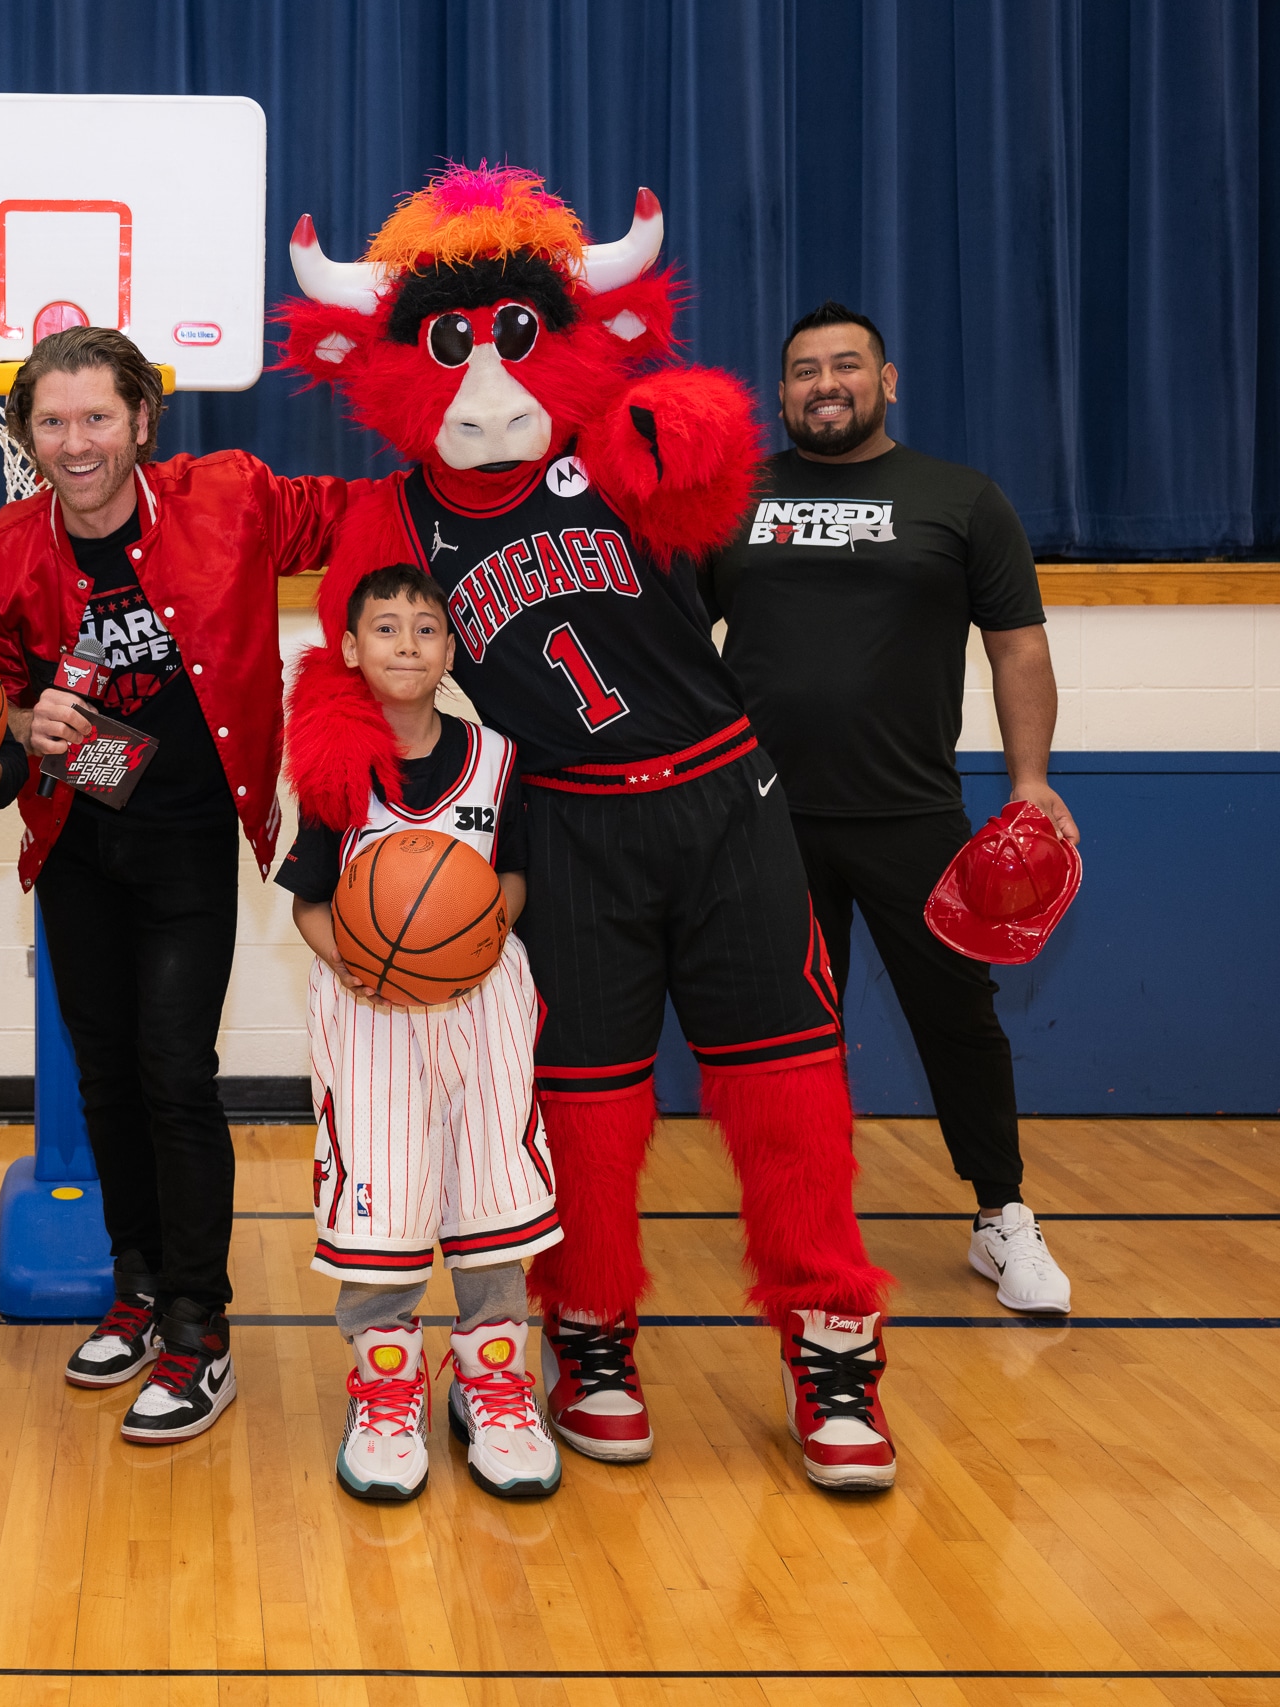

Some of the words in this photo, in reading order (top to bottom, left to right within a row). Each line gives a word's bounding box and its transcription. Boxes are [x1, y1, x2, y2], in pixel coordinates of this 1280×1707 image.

[754, 502, 892, 525] INCREDI
[448, 528, 642, 663] CHICAGO
[543, 622, 630, 733] 1
[454, 806, 495, 833] 312
[826, 1315, 861, 1334] Benny
